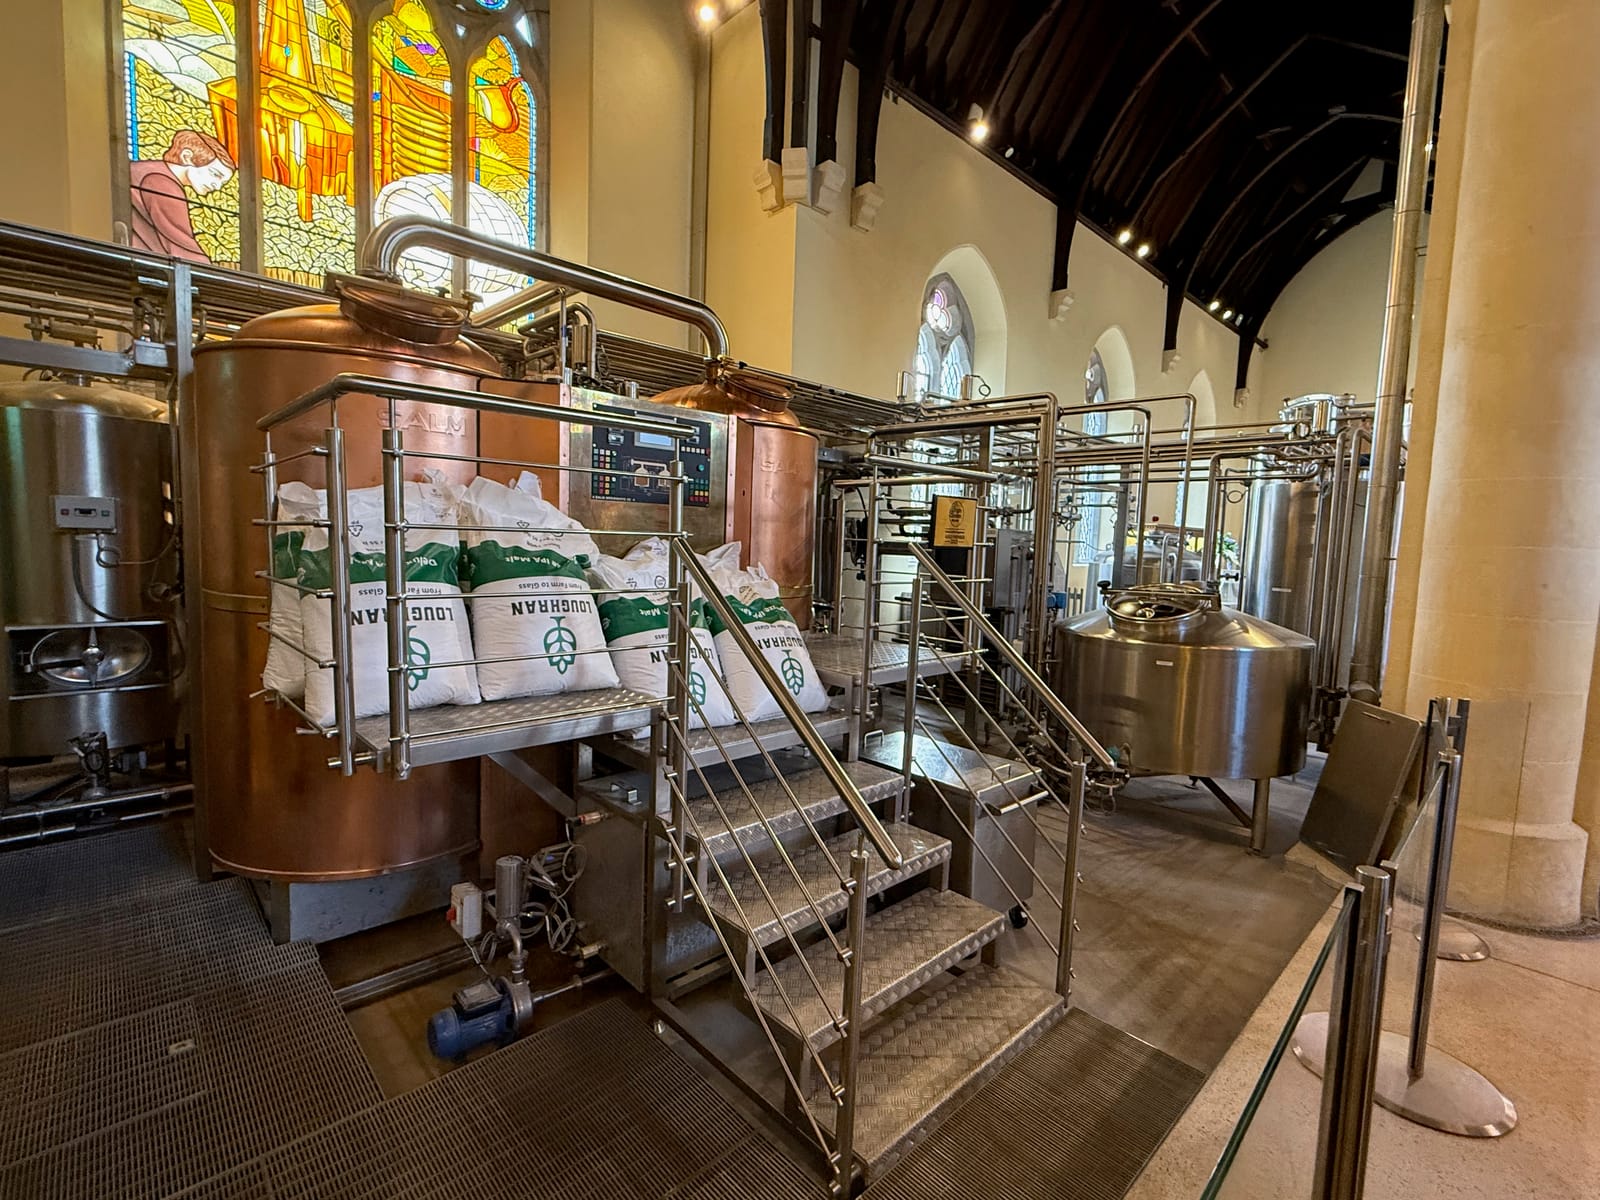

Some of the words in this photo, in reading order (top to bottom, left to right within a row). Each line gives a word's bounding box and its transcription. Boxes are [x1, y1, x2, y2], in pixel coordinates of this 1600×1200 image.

[377, 407, 467, 438] SALM
[504, 555, 531, 563] Malt
[532, 556, 550, 565] IPA
[358, 588, 384, 596] Glass
[421, 587, 442, 595] From
[510, 599, 592, 616] LOUGHRAN
[639, 607, 661, 617] Malt
[350, 606, 453, 626] LOUGAN
